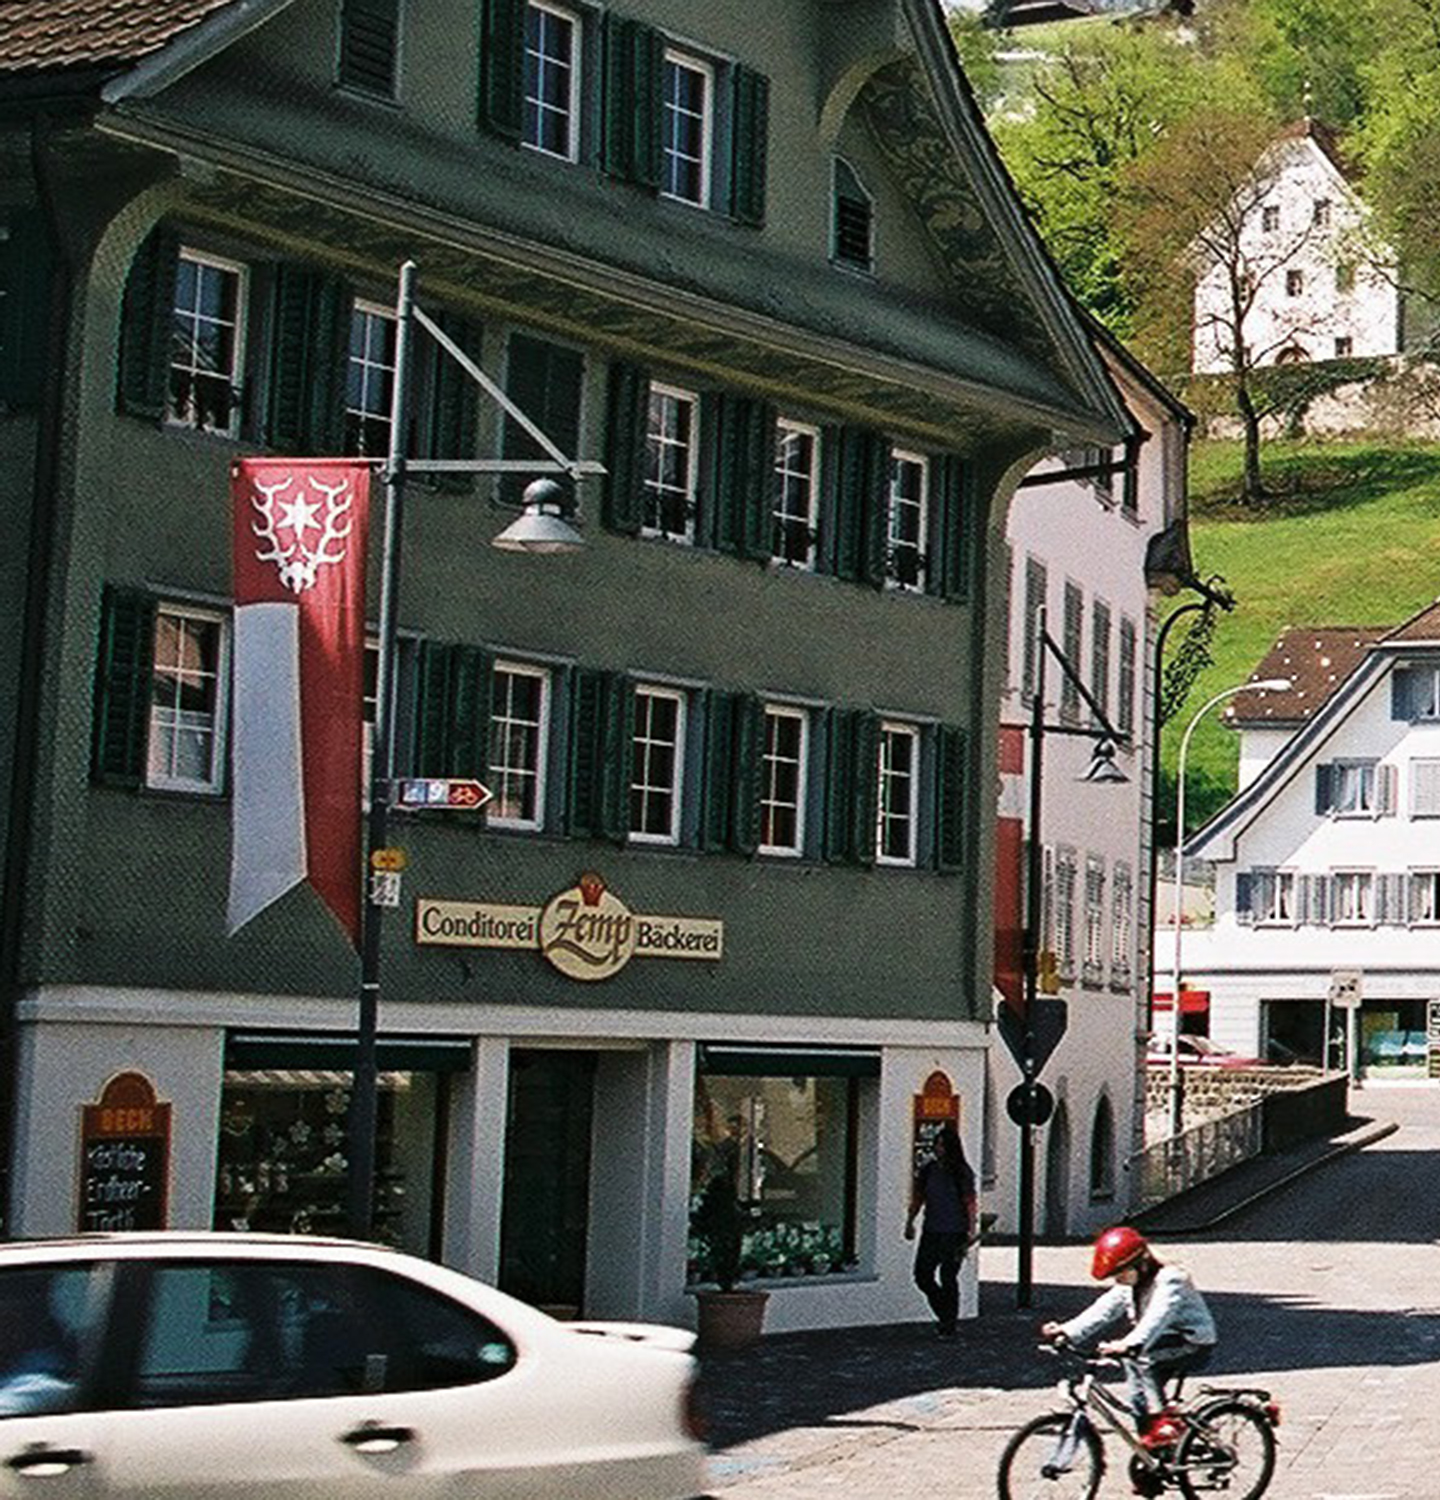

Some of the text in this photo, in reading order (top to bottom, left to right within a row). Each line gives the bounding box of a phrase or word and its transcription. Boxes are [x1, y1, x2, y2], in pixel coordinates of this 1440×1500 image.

[421, 899, 719, 966] Conditorei Zemp Bäckerei
[99, 1108, 153, 1131] BECK
